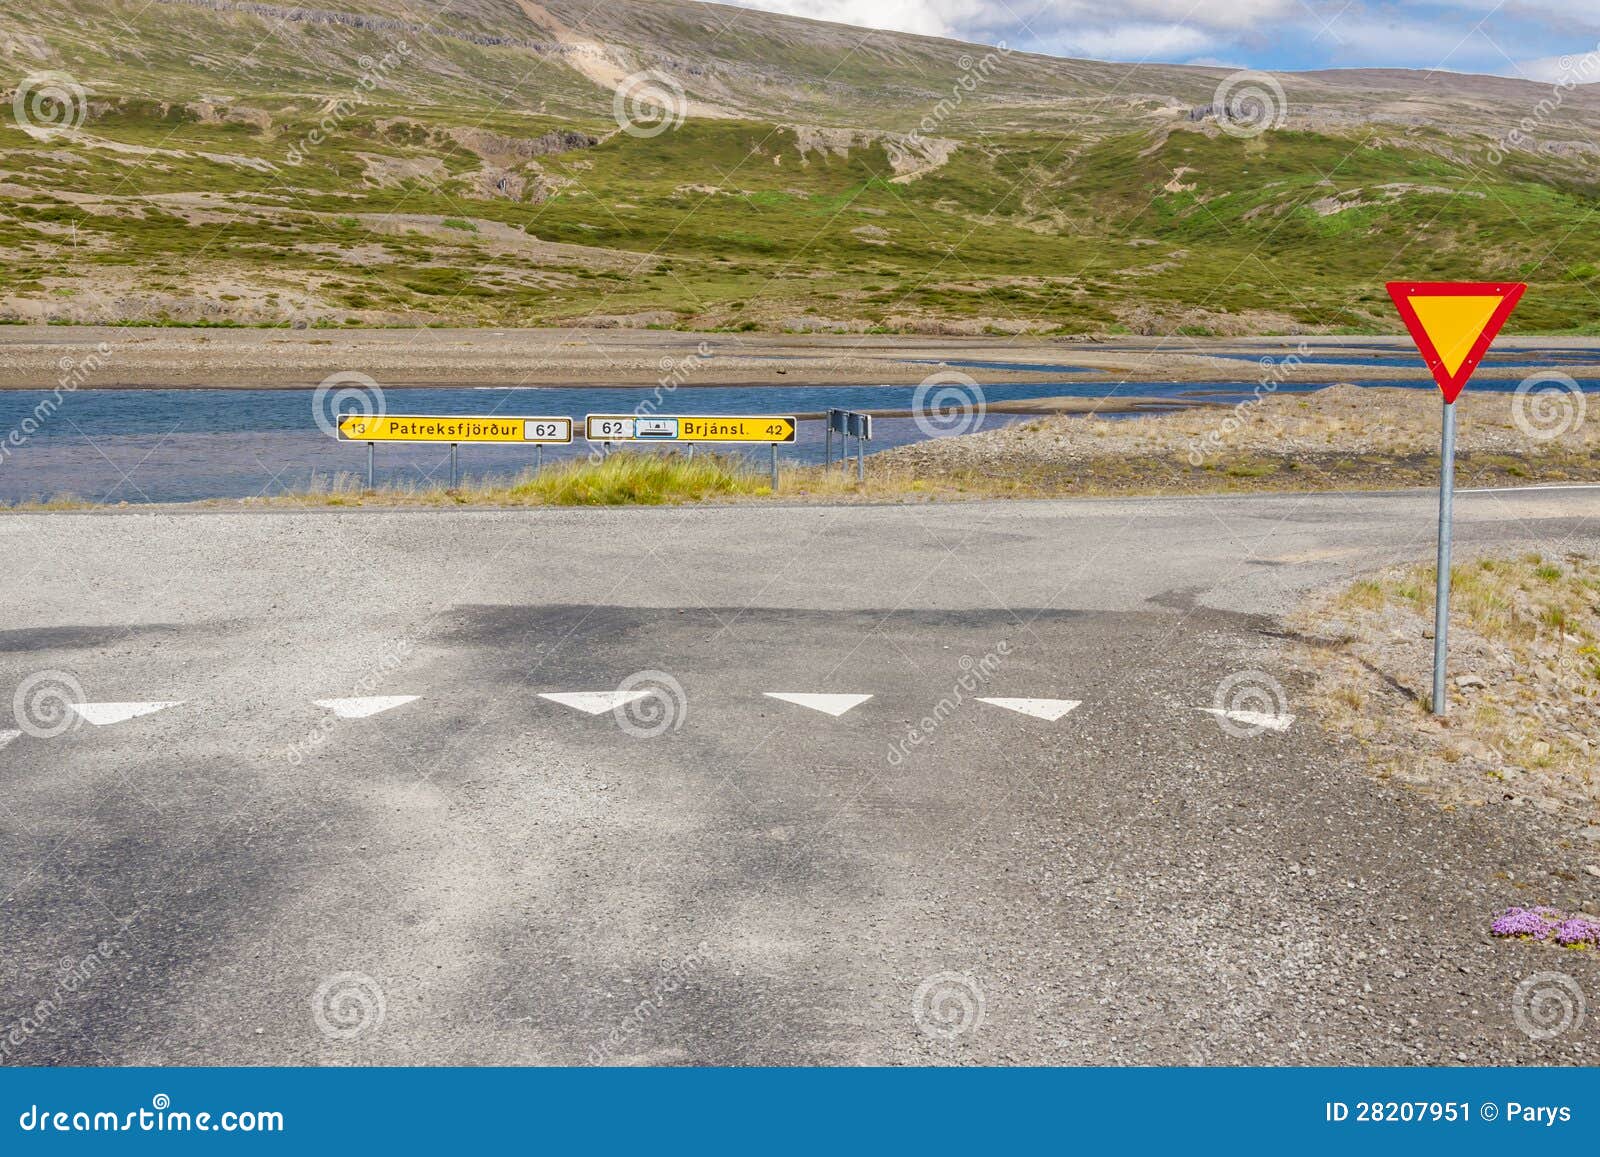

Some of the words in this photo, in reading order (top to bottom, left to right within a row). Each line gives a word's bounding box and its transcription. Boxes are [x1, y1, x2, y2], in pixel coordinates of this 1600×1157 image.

[351, 423, 366, 434] 13
[390, 422, 518, 437] Patreksfjörður
[536, 424, 557, 437] 62
[602, 422, 623, 434] 62
[684, 422, 750, 437] Brjánsl.
[765, 425, 783, 435] 42
